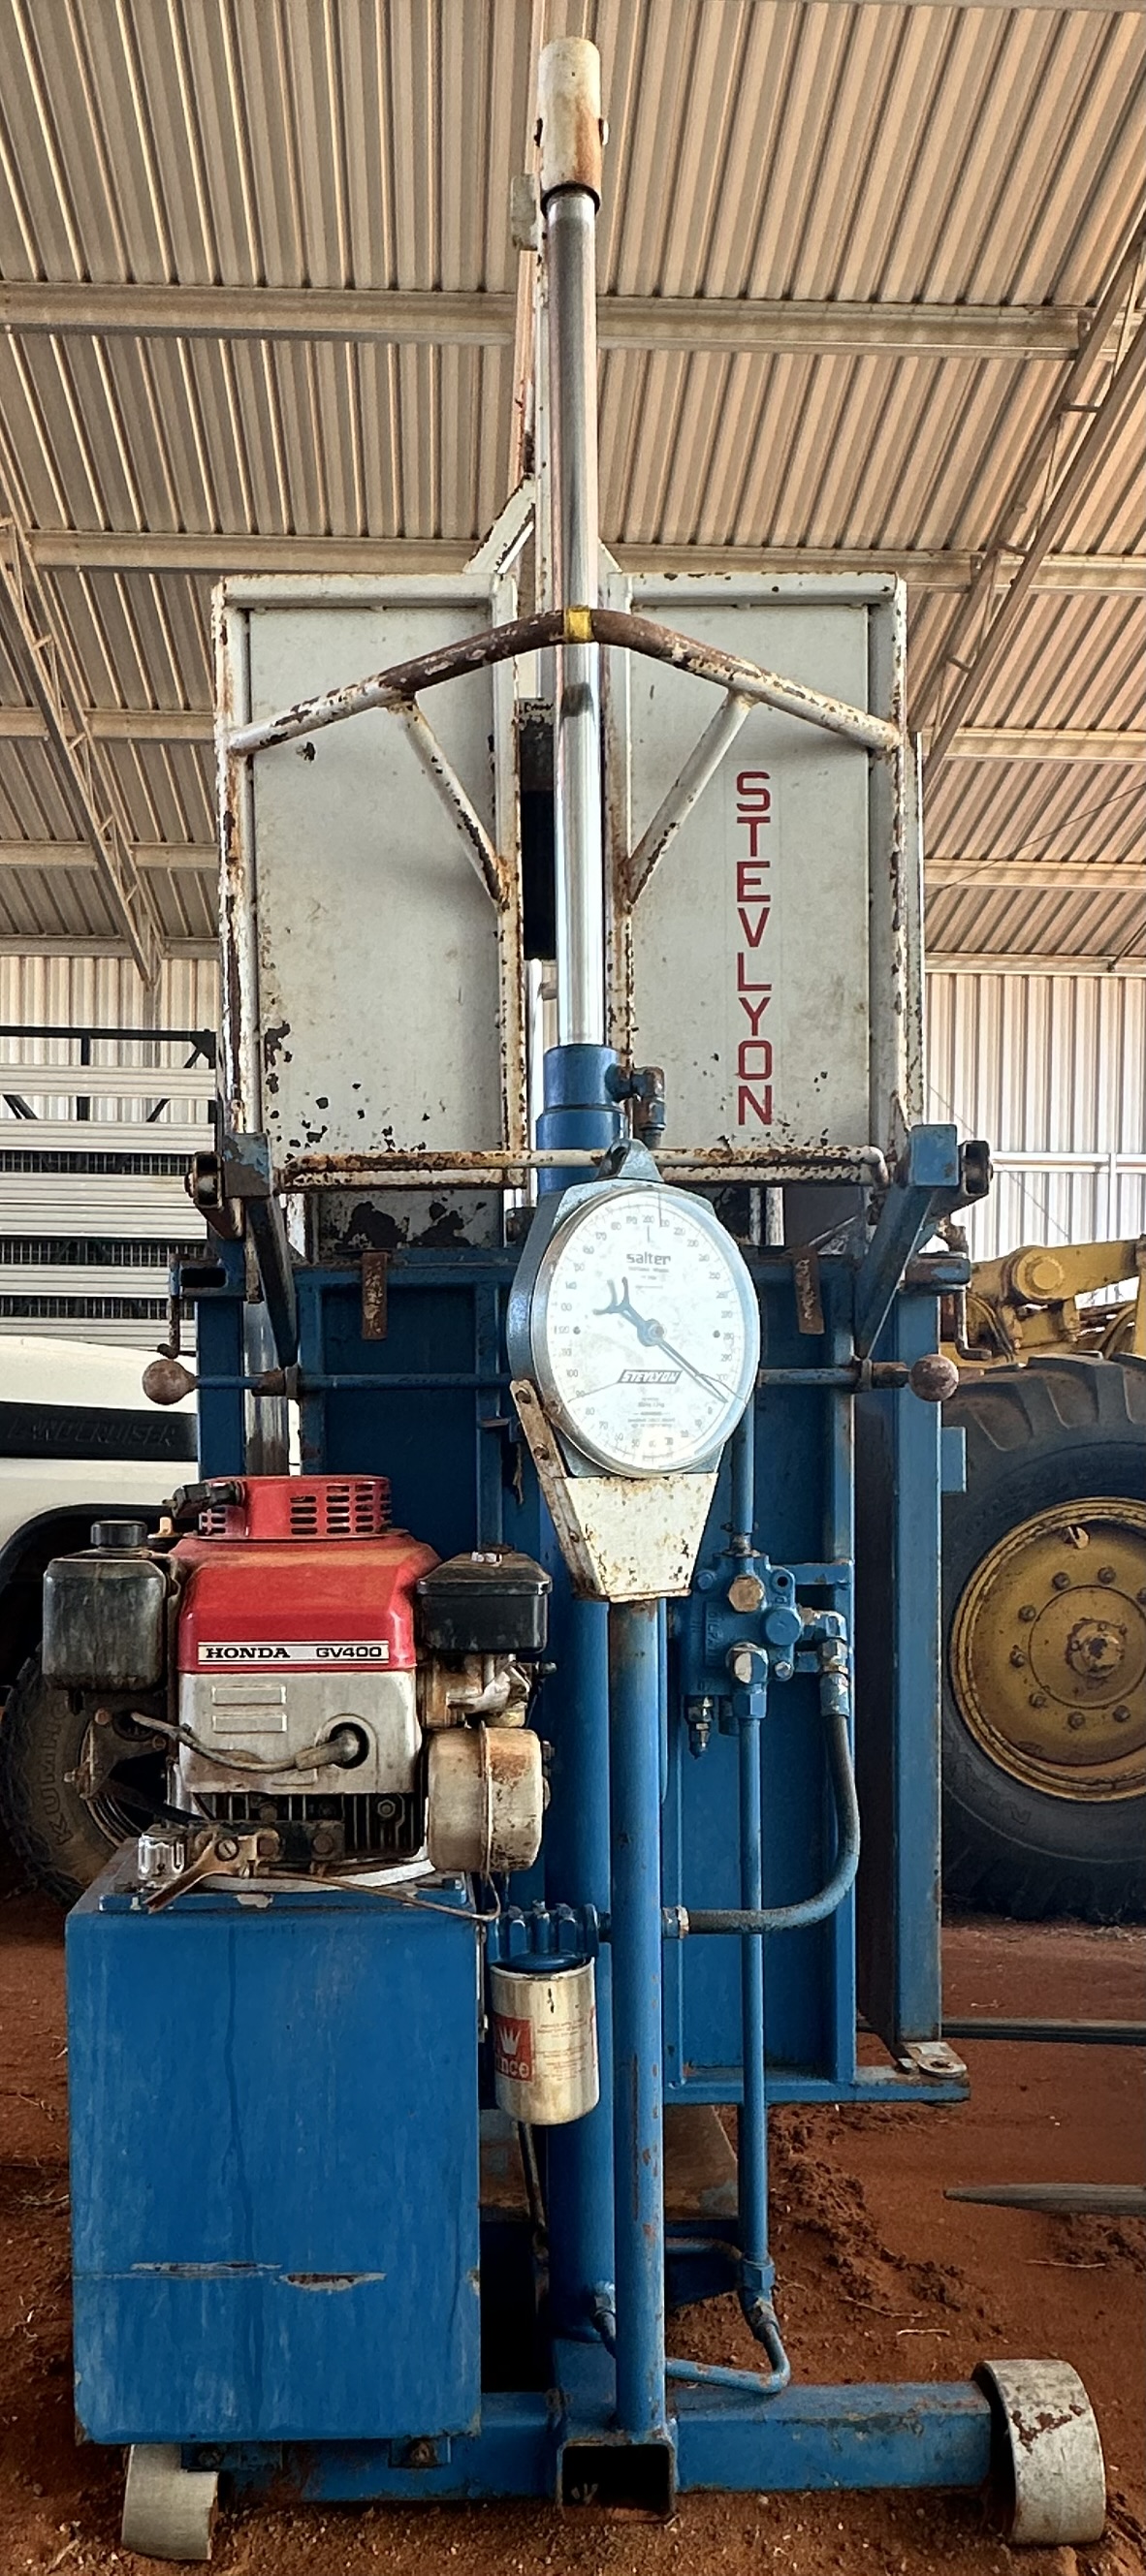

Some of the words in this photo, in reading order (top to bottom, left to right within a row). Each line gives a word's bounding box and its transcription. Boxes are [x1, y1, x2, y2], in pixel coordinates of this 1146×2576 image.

[736, 770, 772, 1126] STEVLYON
[626, 1251, 671, 1265] salter
[621, 1370, 680, 1383] STEVLYON
[206, 1647, 291, 1659] HONDA
[316, 1647, 382, 1658] GV400
